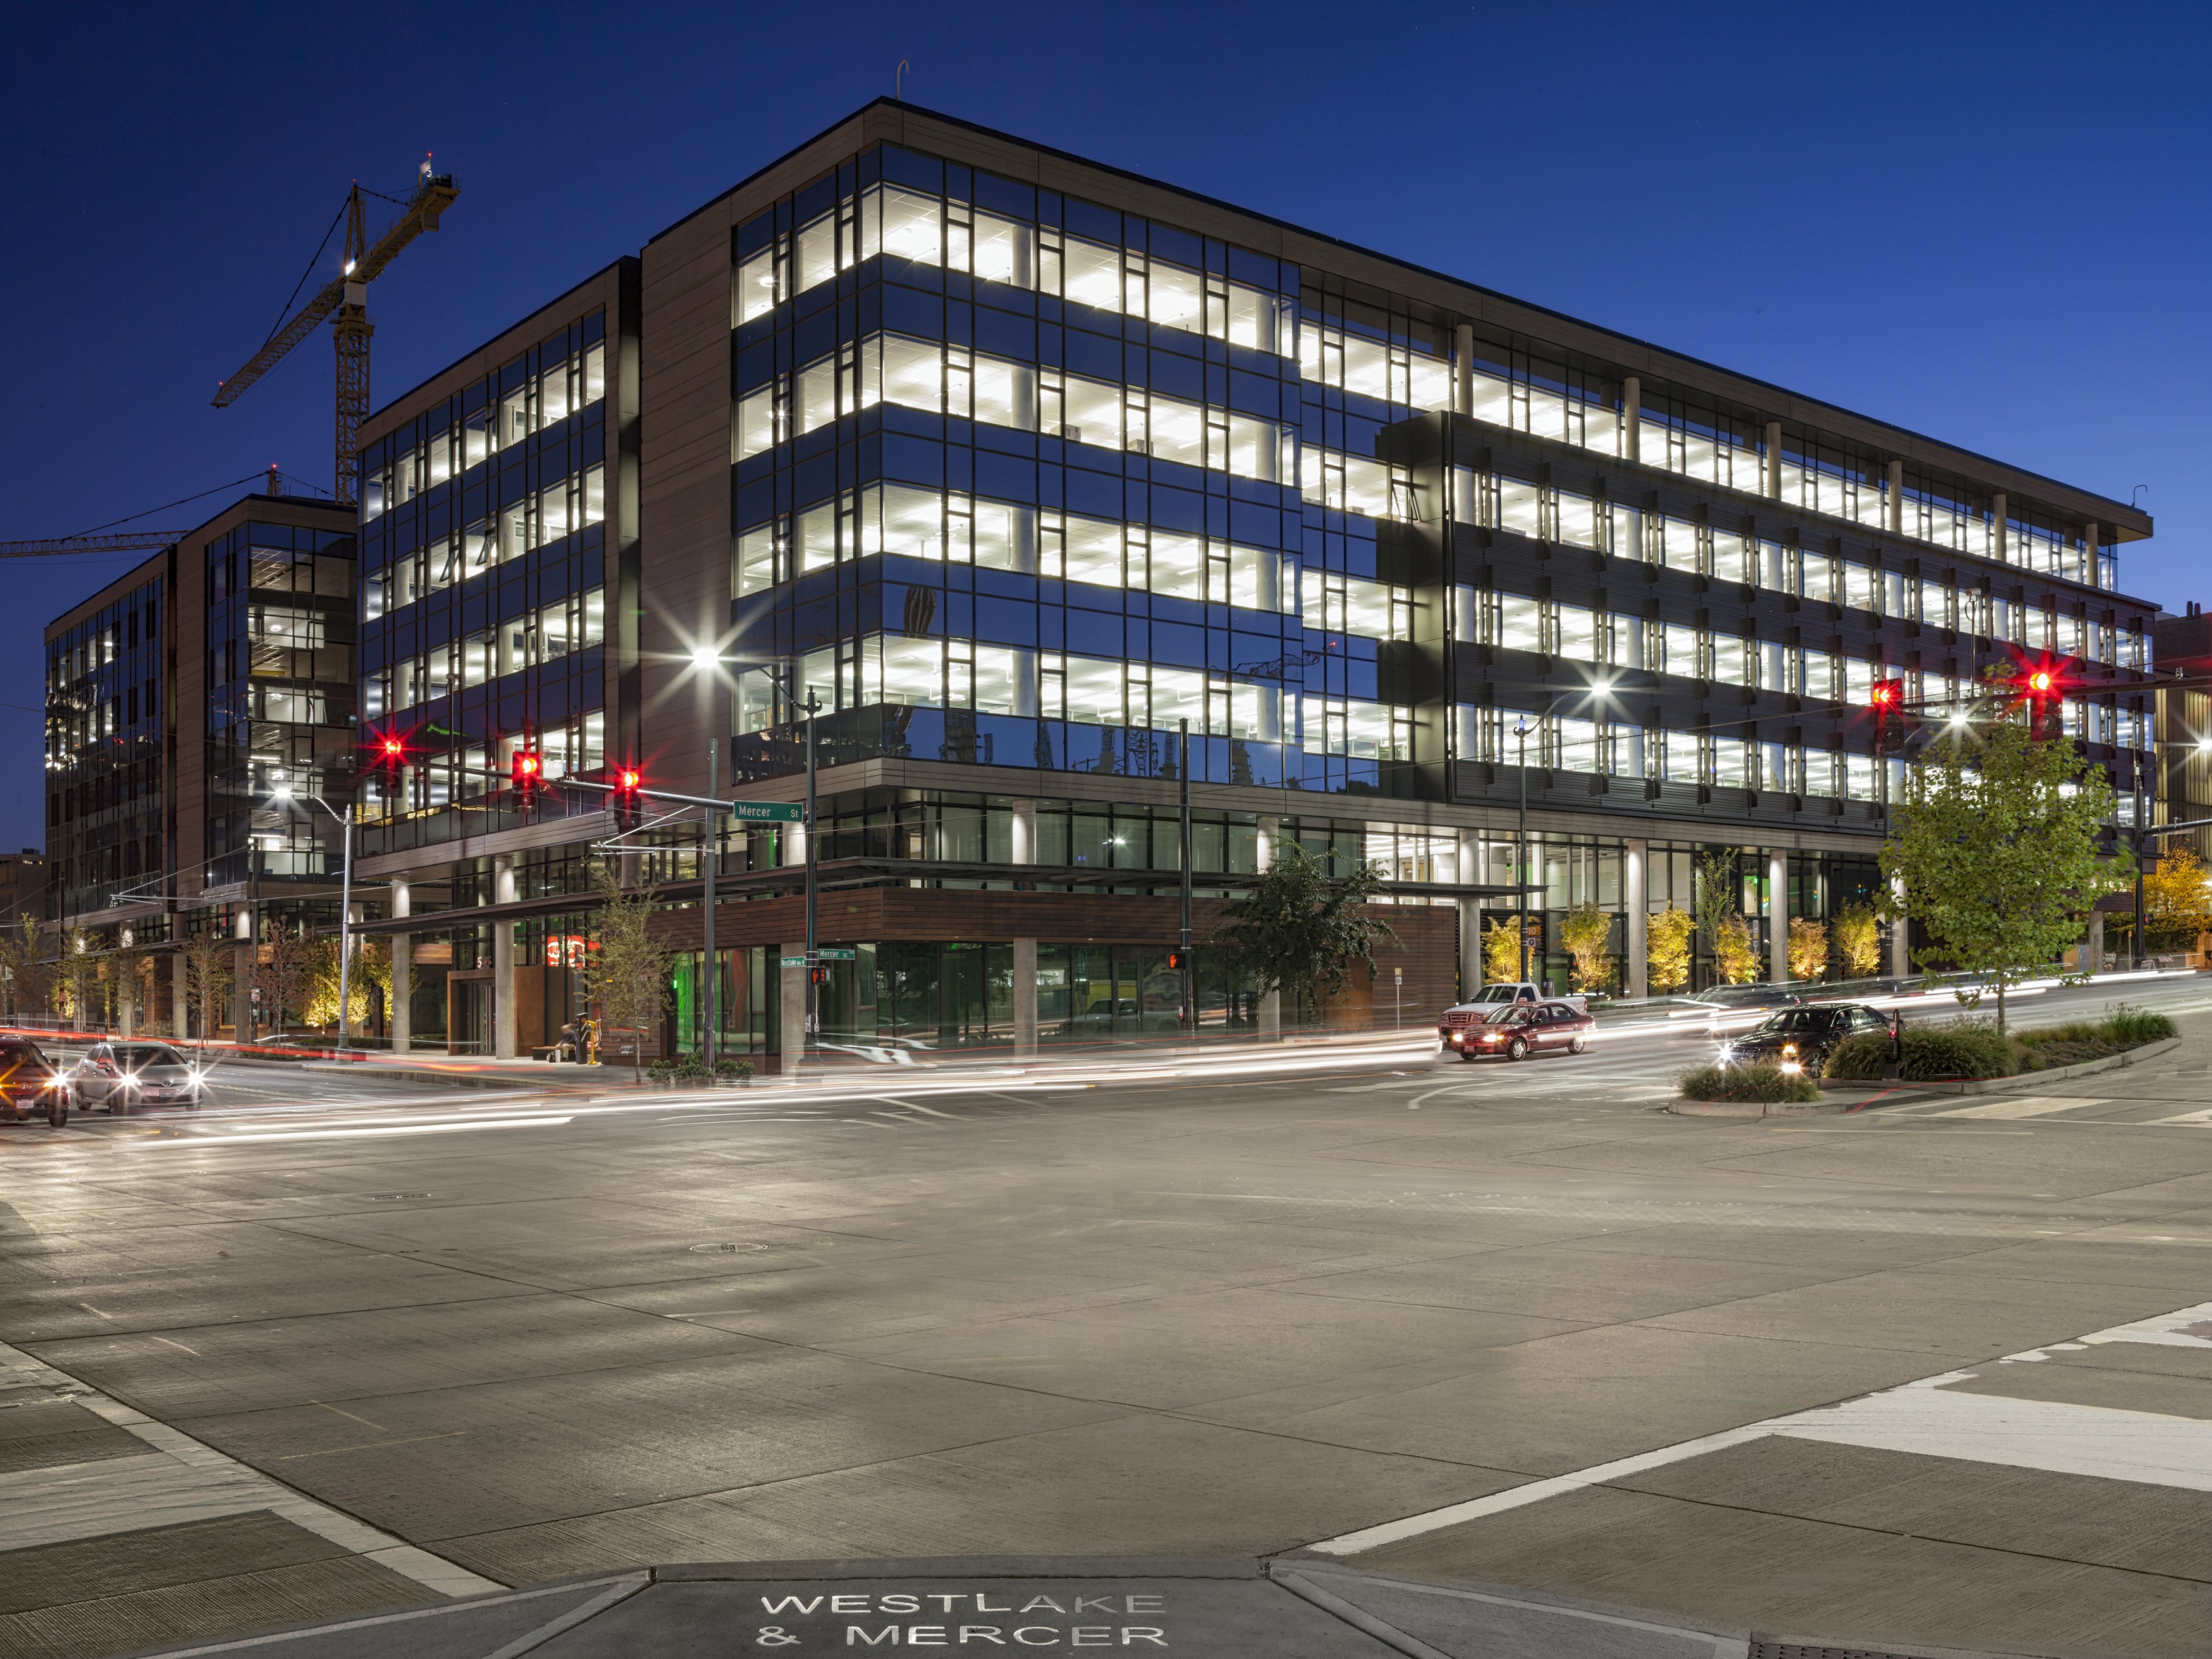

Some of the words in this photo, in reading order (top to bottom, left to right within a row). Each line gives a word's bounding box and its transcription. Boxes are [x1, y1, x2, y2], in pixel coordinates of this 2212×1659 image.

[739, 804, 771, 817] Mercer
[790, 809, 799, 818] St
[820, 950, 838, 958] Mercer
[782, 959, 796, 967] Westlake
[760, 1593, 1166, 1614] WESTLAKE
[756, 1626, 802, 1646] &
[846, 1626, 1169, 1646] MERCER
